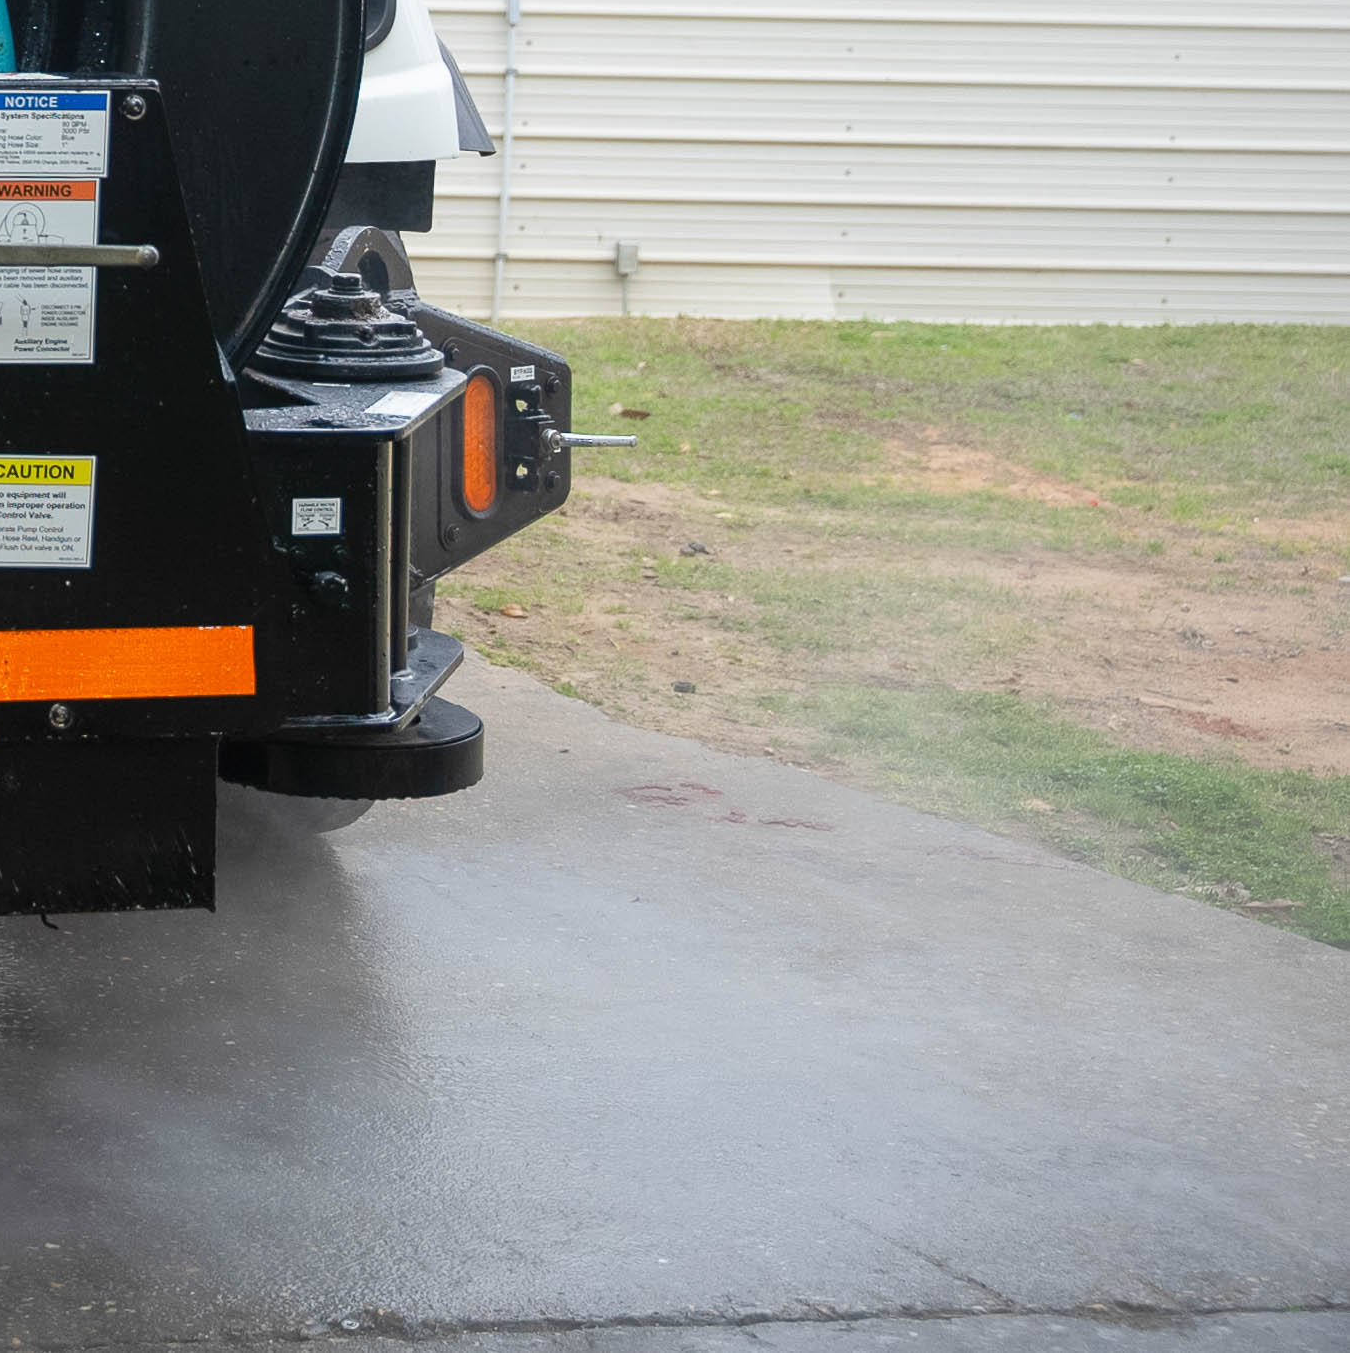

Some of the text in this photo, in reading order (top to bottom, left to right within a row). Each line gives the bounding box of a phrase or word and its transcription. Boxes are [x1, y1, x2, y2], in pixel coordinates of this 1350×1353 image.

[4, 96, 58, 108] NOTICE
[1, 112, 29, 120] System
[31, 112, 85, 120] Specifications
[6, 491, 50, 500] equipment
[52, 491, 67, 499] will
[7, 501, 44, 510] improper
[46, 501, 86, 510] operation
[28, 511, 53, 519] Valve.
